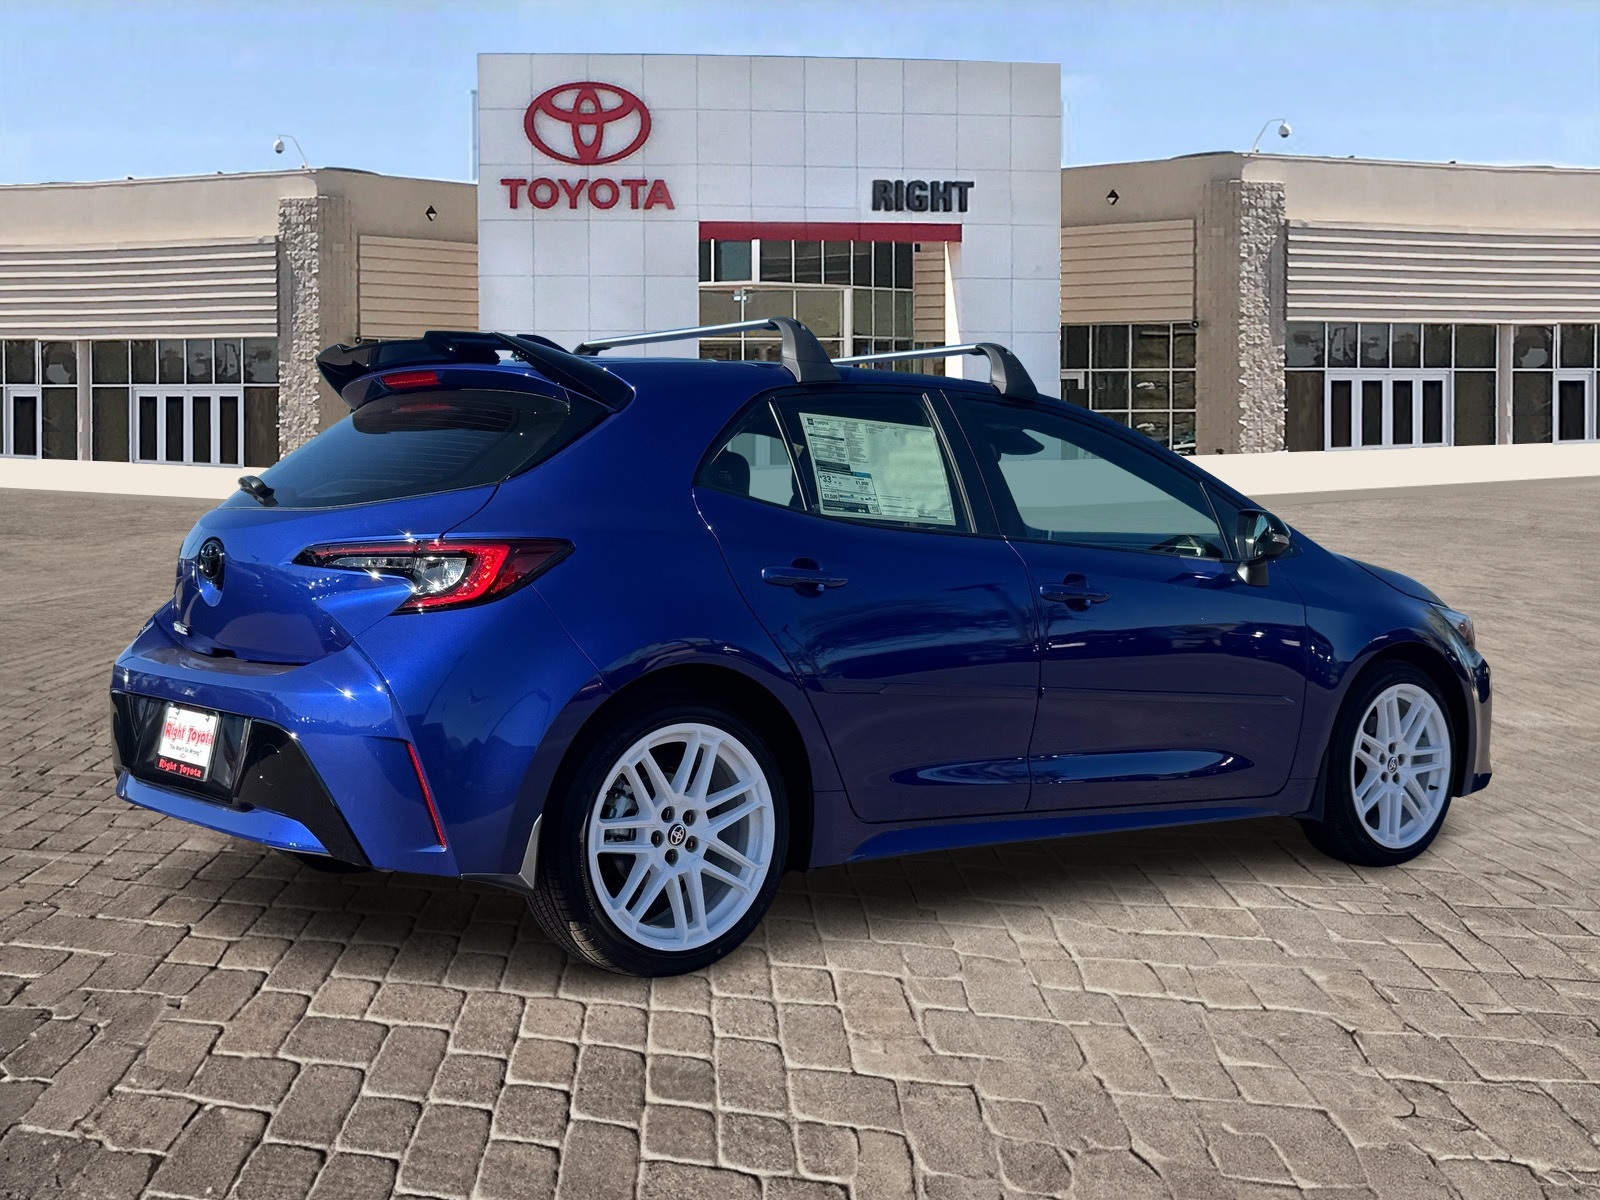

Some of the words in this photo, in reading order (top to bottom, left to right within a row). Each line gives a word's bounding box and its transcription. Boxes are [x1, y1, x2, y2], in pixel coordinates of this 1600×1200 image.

[500, 178, 675, 210] TOYOTA
[872, 179, 975, 213] RIGHT
[822, 475, 832, 483] 33
[164, 721, 185, 742] Right
[187, 726, 214, 747] Toyota
[158, 758, 177, 771] Right
[180, 764, 202, 777] Toyota
